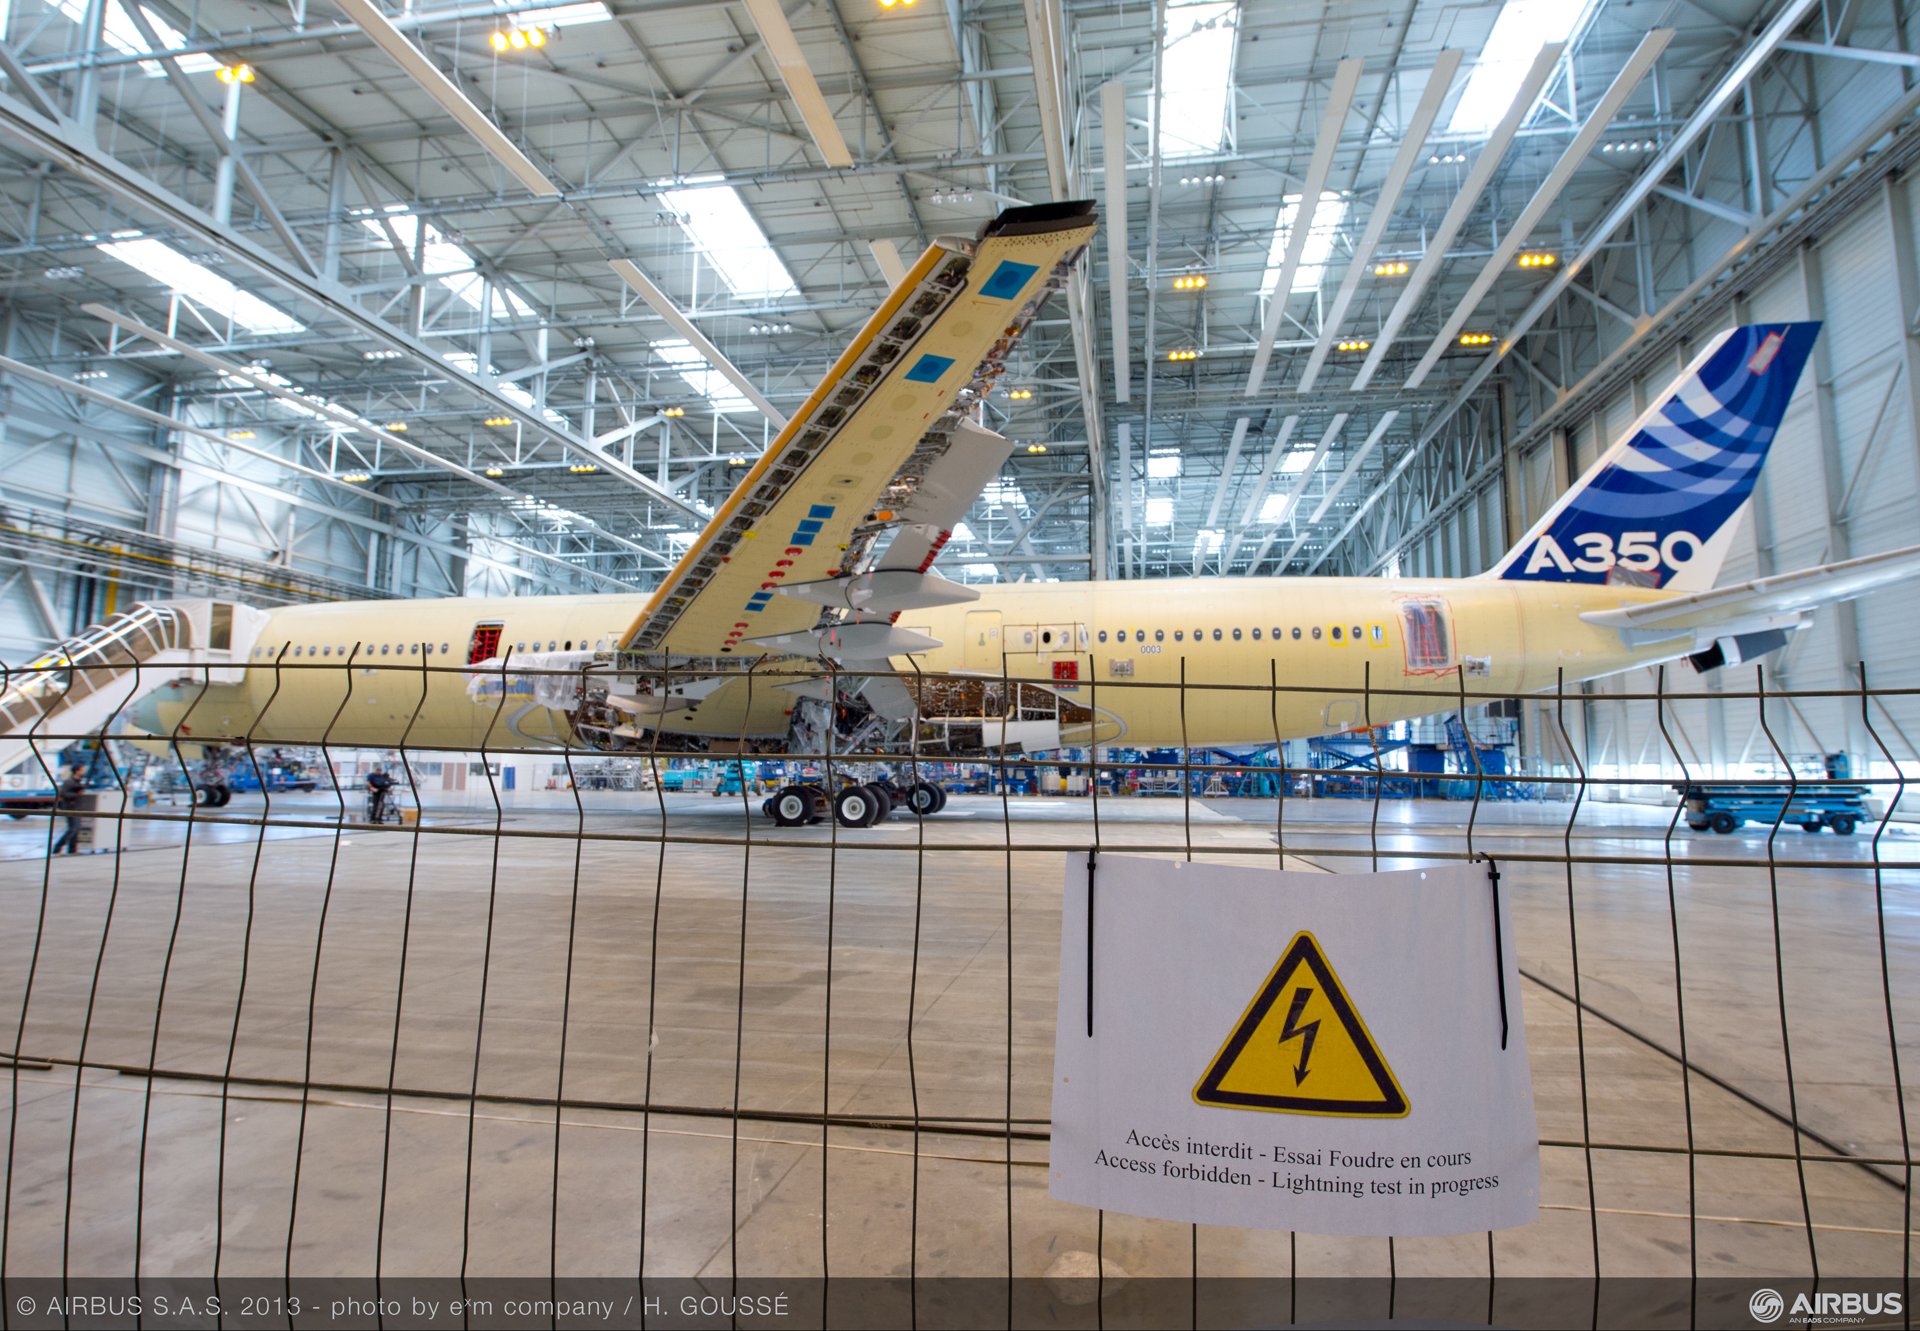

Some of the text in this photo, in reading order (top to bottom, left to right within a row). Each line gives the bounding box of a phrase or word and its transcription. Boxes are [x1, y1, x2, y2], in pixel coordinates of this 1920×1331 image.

[1524, 530, 1702, 574] A350
[1140, 645, 1161, 654] 0003
[1126, 1128, 1180, 1152] Accès
[1186, 1136, 1254, 1160] interdit
[1273, 1146, 1322, 1166] Essai
[1329, 1150, 1395, 1169] Foudre
[1400, 1156, 1422, 1168] en
[1427, 1152, 1472, 1168] cours
[1094, 1149, 1156, 1175] Access
[1163, 1160, 1252, 1186] forbidden
[1272, 1172, 1364, 1198] Lightning
[1371, 1179, 1402, 1195] test
[1409, 1178, 1425, 1195] in
[1431, 1175, 1499, 1198] progress
